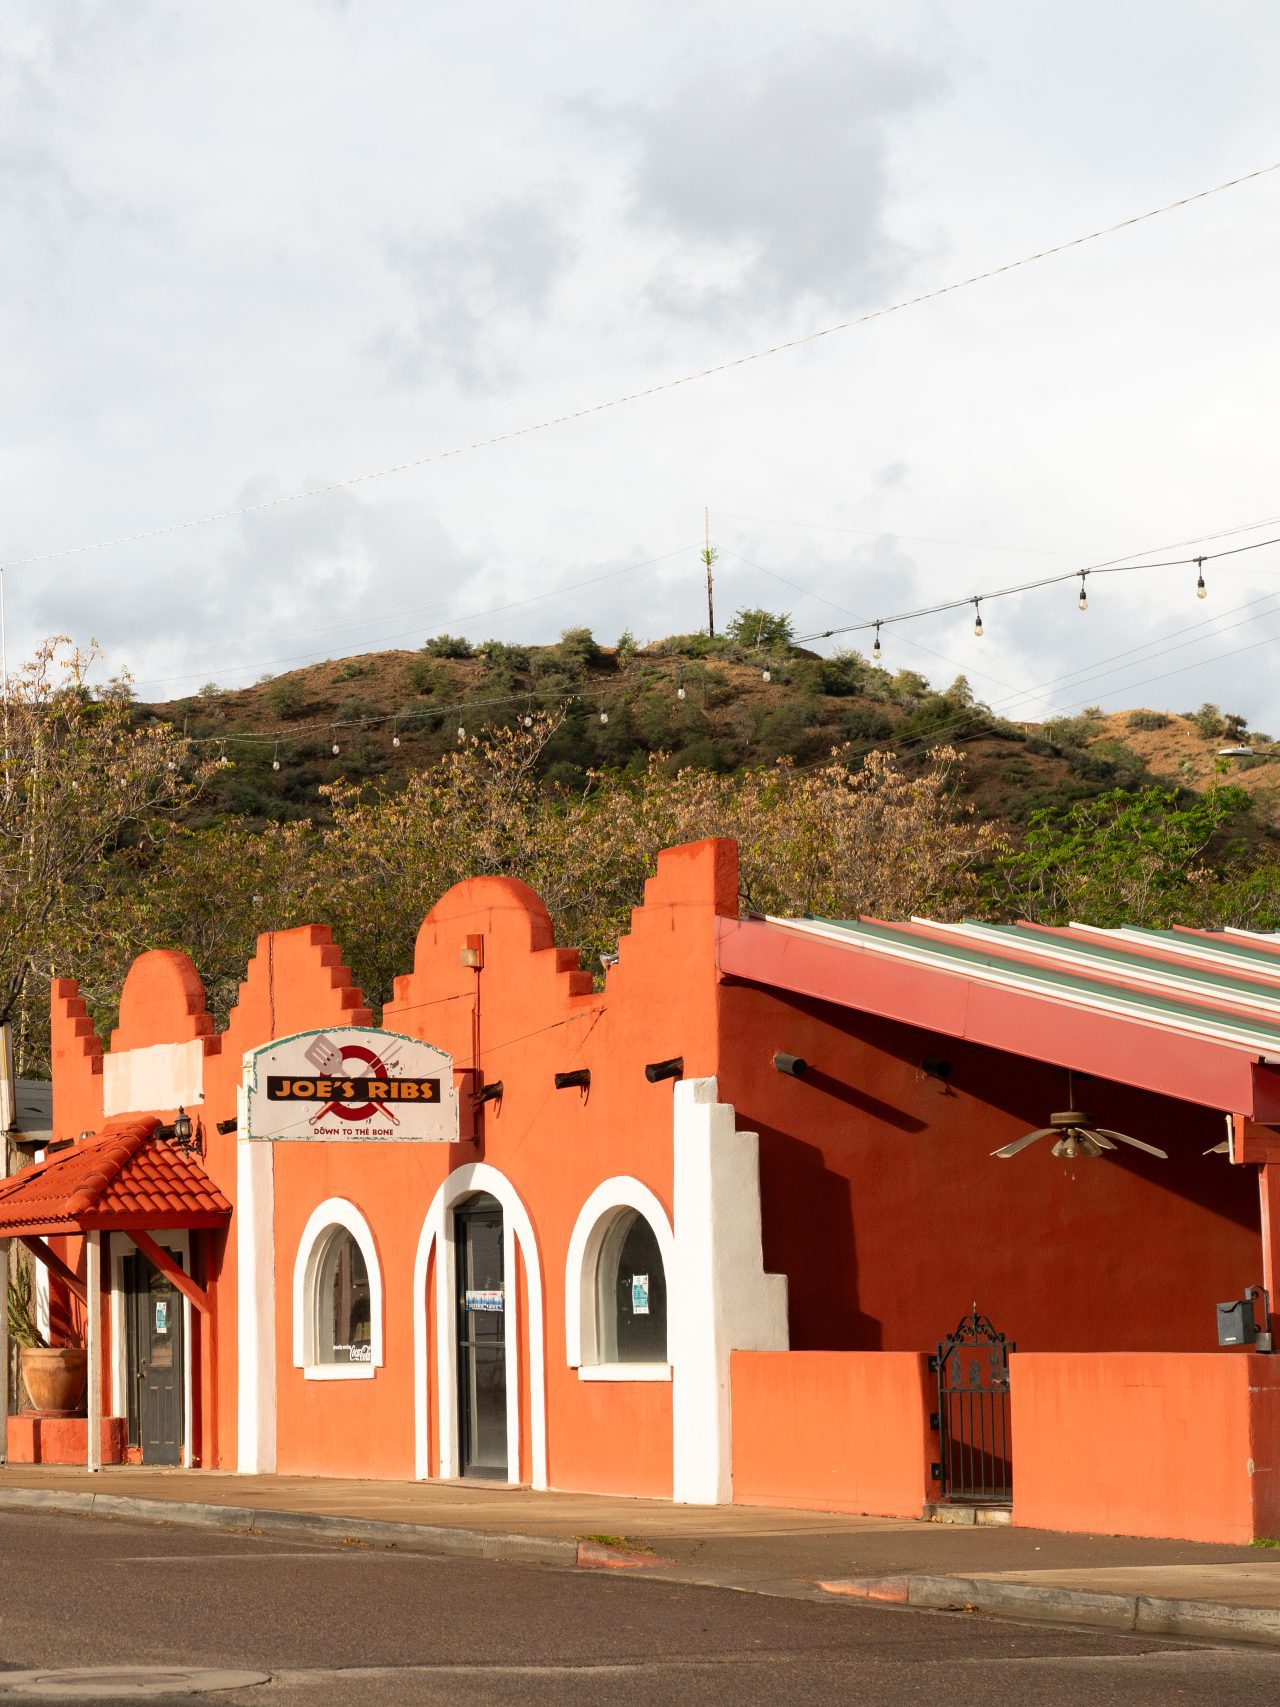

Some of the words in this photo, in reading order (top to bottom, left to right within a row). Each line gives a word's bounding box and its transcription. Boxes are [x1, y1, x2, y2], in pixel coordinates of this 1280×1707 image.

[276, 1080, 355, 1098] JOE'S
[368, 1082, 433, 1100] RIBS
[314, 1127, 340, 1136] DOWN
[342, 1128, 353, 1136] TO
[355, 1128, 370, 1136] THE
[372, 1128, 394, 1136] BONE
